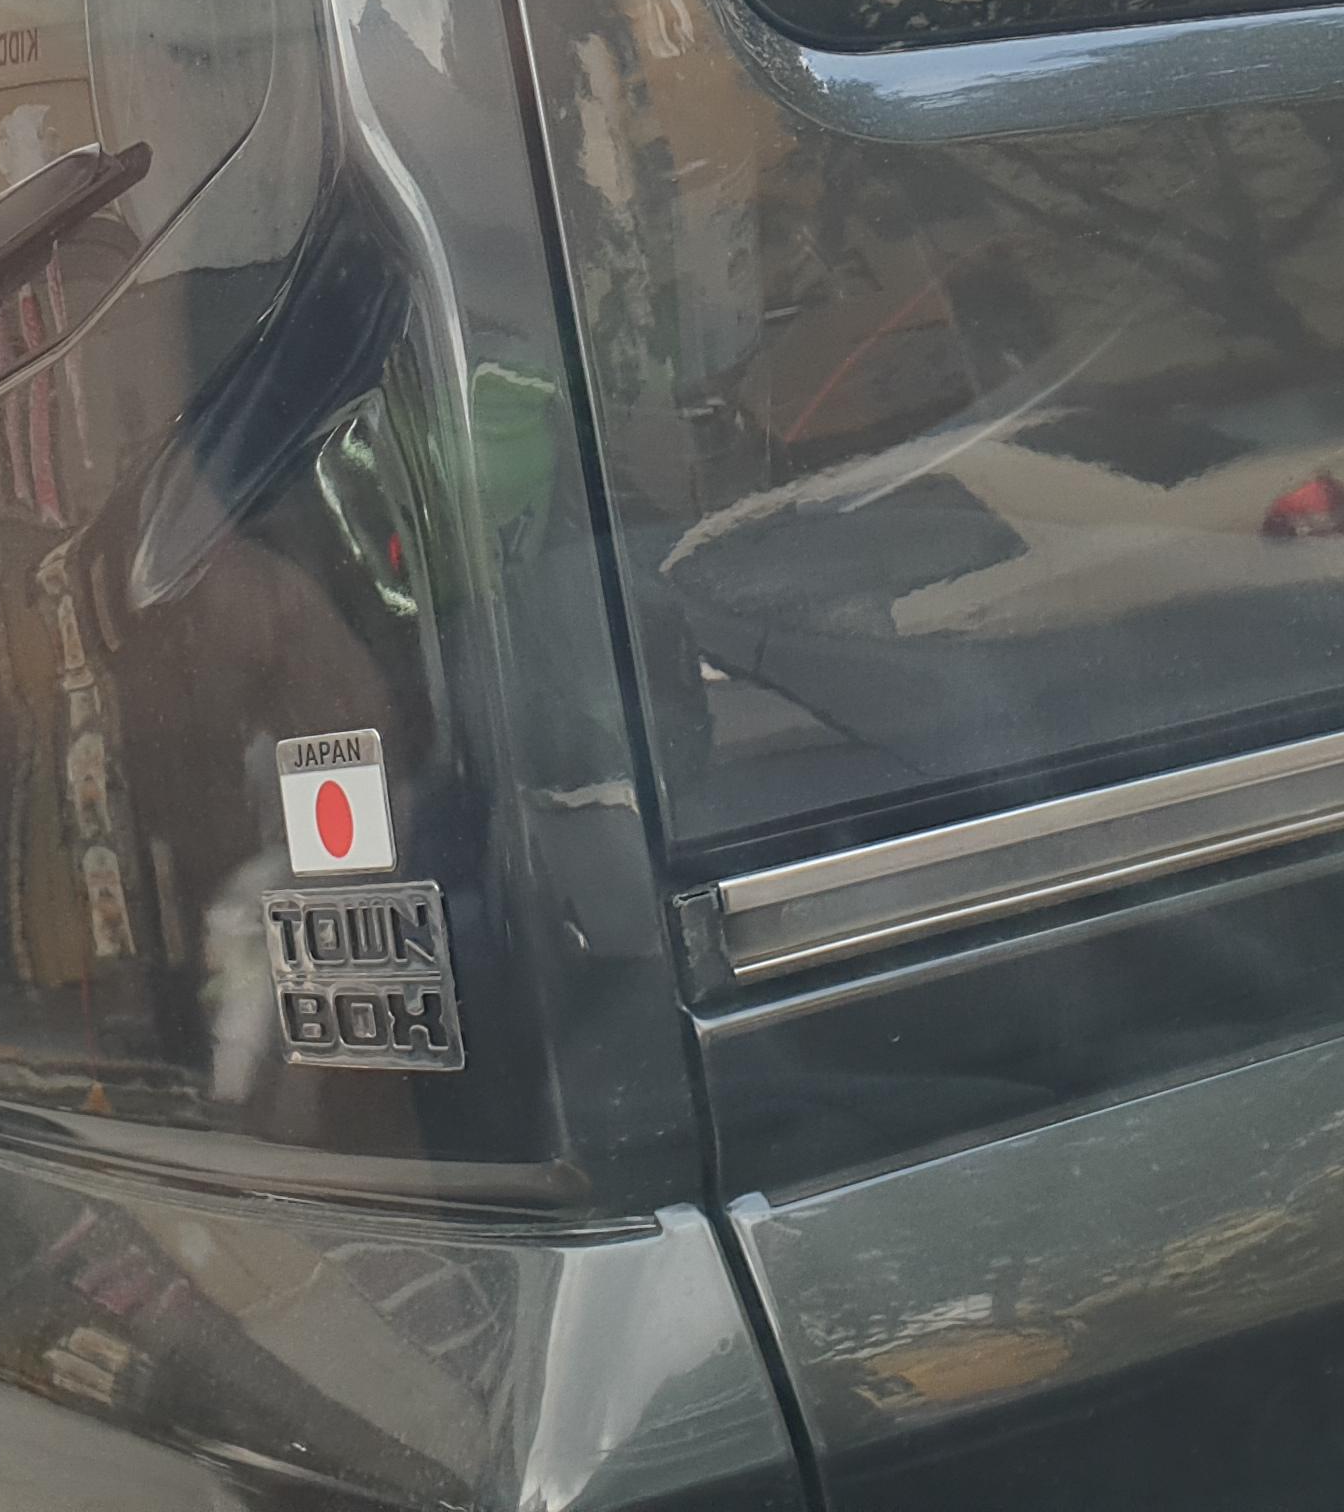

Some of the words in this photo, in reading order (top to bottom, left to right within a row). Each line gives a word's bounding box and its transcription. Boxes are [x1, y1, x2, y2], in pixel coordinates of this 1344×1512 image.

[294, 738, 361, 768] JAPAN
[271, 901, 438, 964] TOWN
[282, 991, 449, 1052] BOX
